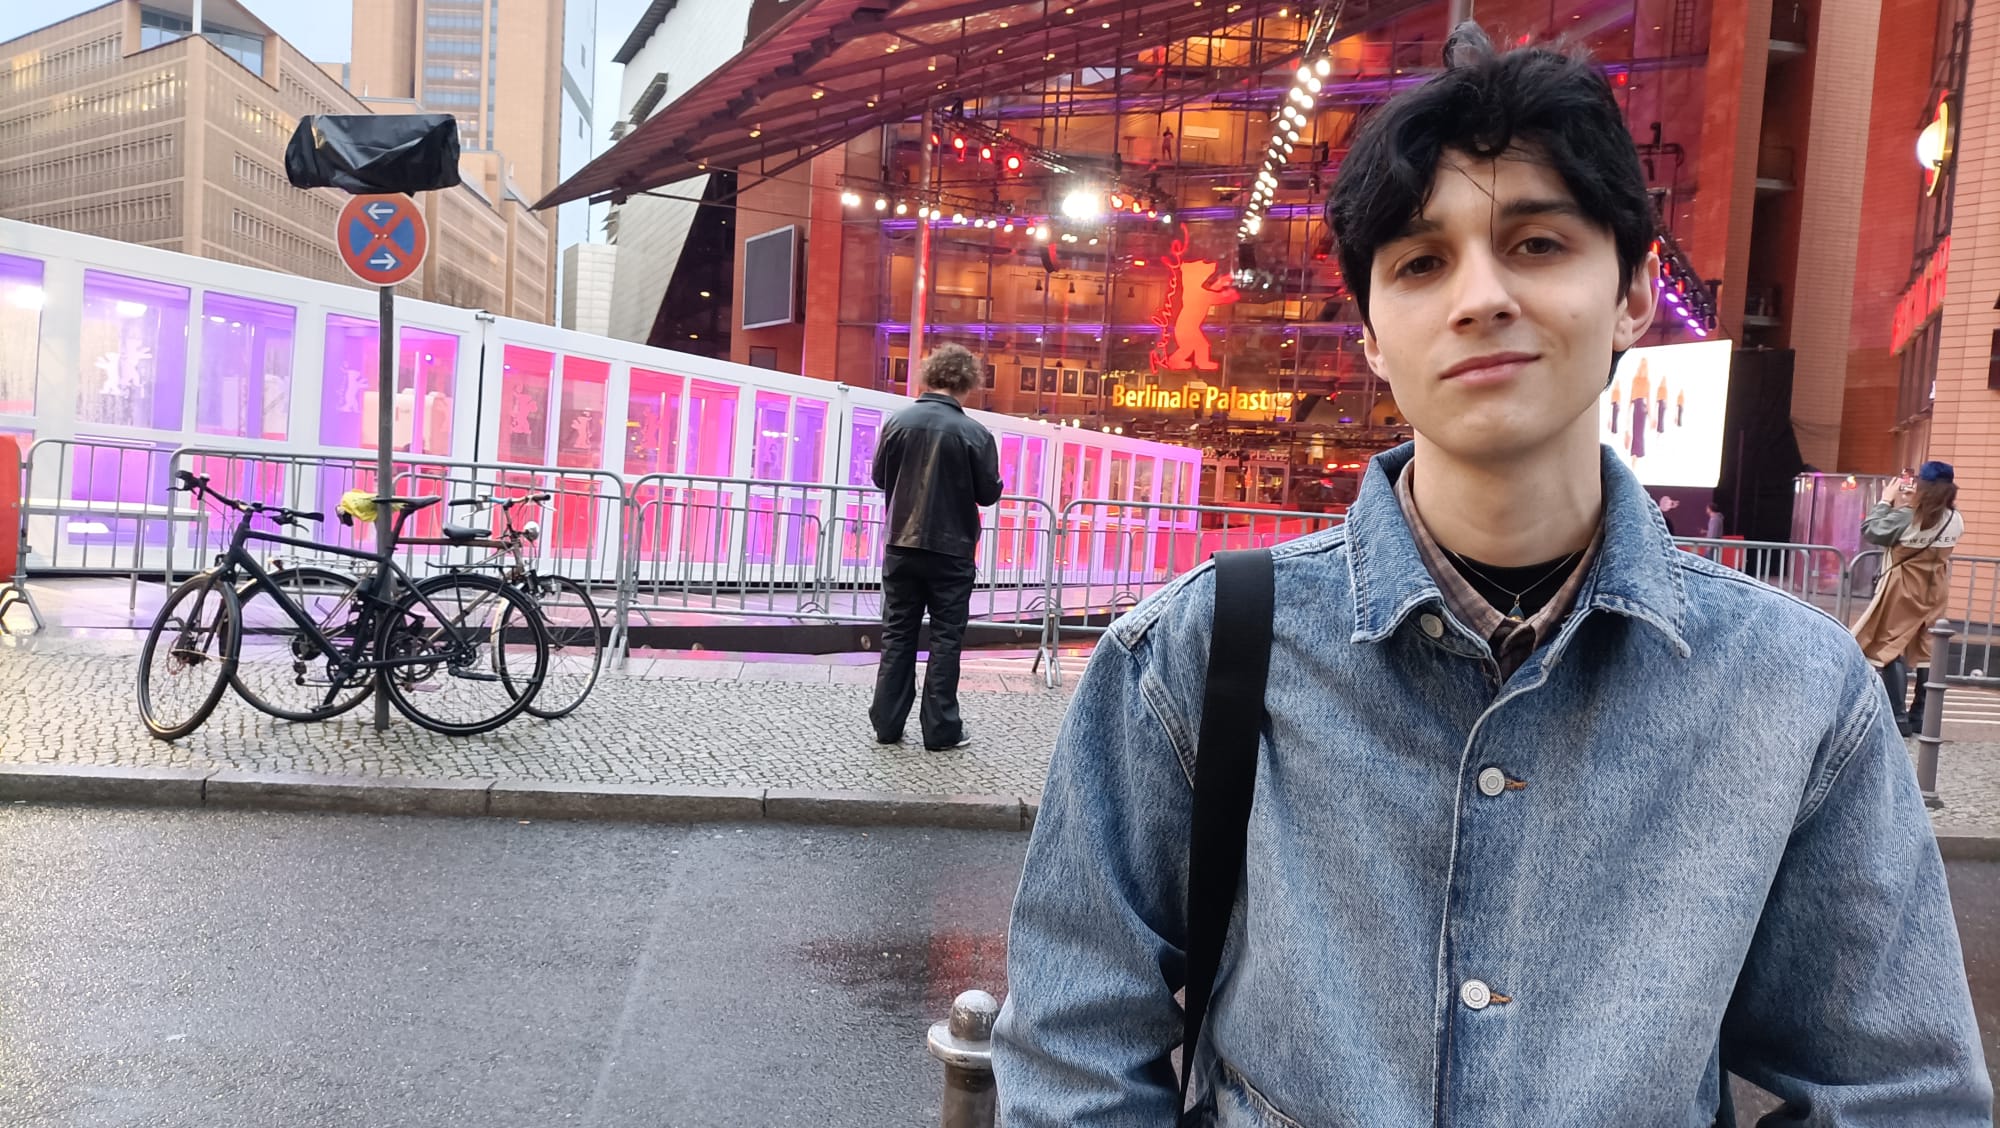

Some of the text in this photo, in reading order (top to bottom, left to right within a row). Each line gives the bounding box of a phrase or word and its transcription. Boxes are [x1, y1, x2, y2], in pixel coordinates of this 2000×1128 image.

[1150, 222, 1190, 374] Berlinale
[1112, 384, 1268, 411] Berlinale Palast
